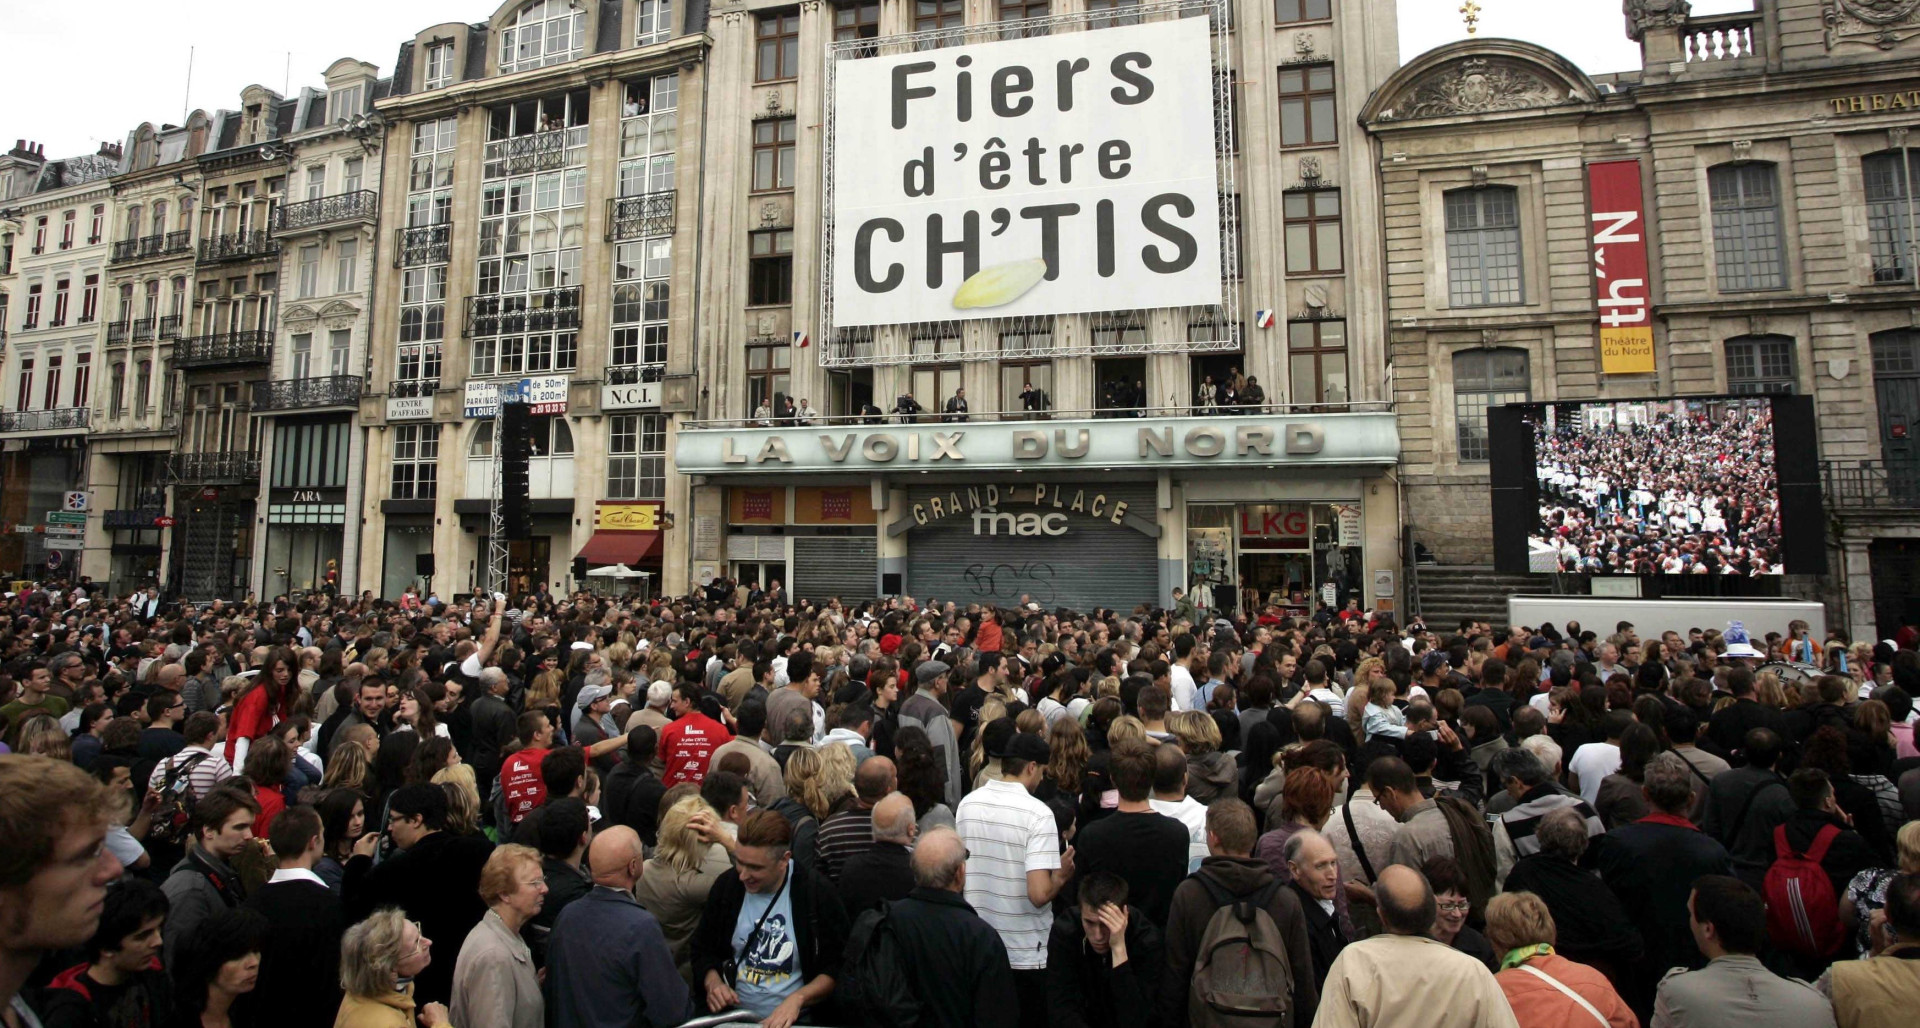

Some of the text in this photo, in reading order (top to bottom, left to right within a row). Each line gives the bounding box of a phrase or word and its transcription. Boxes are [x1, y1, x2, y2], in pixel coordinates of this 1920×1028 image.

[891, 51, 1155, 130] Fiers
[1604, 336, 1647, 346] Théâtre
[1604, 346, 1650, 356] du Nord
[468, 383, 497, 392] BUREAUX
[532, 381, 541, 389] de
[466, 397, 497, 405] PARKINGS
[611, 388, 652, 404] N.C.I.
[396, 400, 423, 408] CENTRE
[391, 408, 430, 417] D'AFFAIRES
[722, 423, 1325, 464] LA VOIX DU NORD
[293, 490, 321, 502] ZARA
[1034, 483, 1128, 525] PLACE
[971, 506, 1068, 536] fnac
[1241, 511, 1307, 535] LKG
